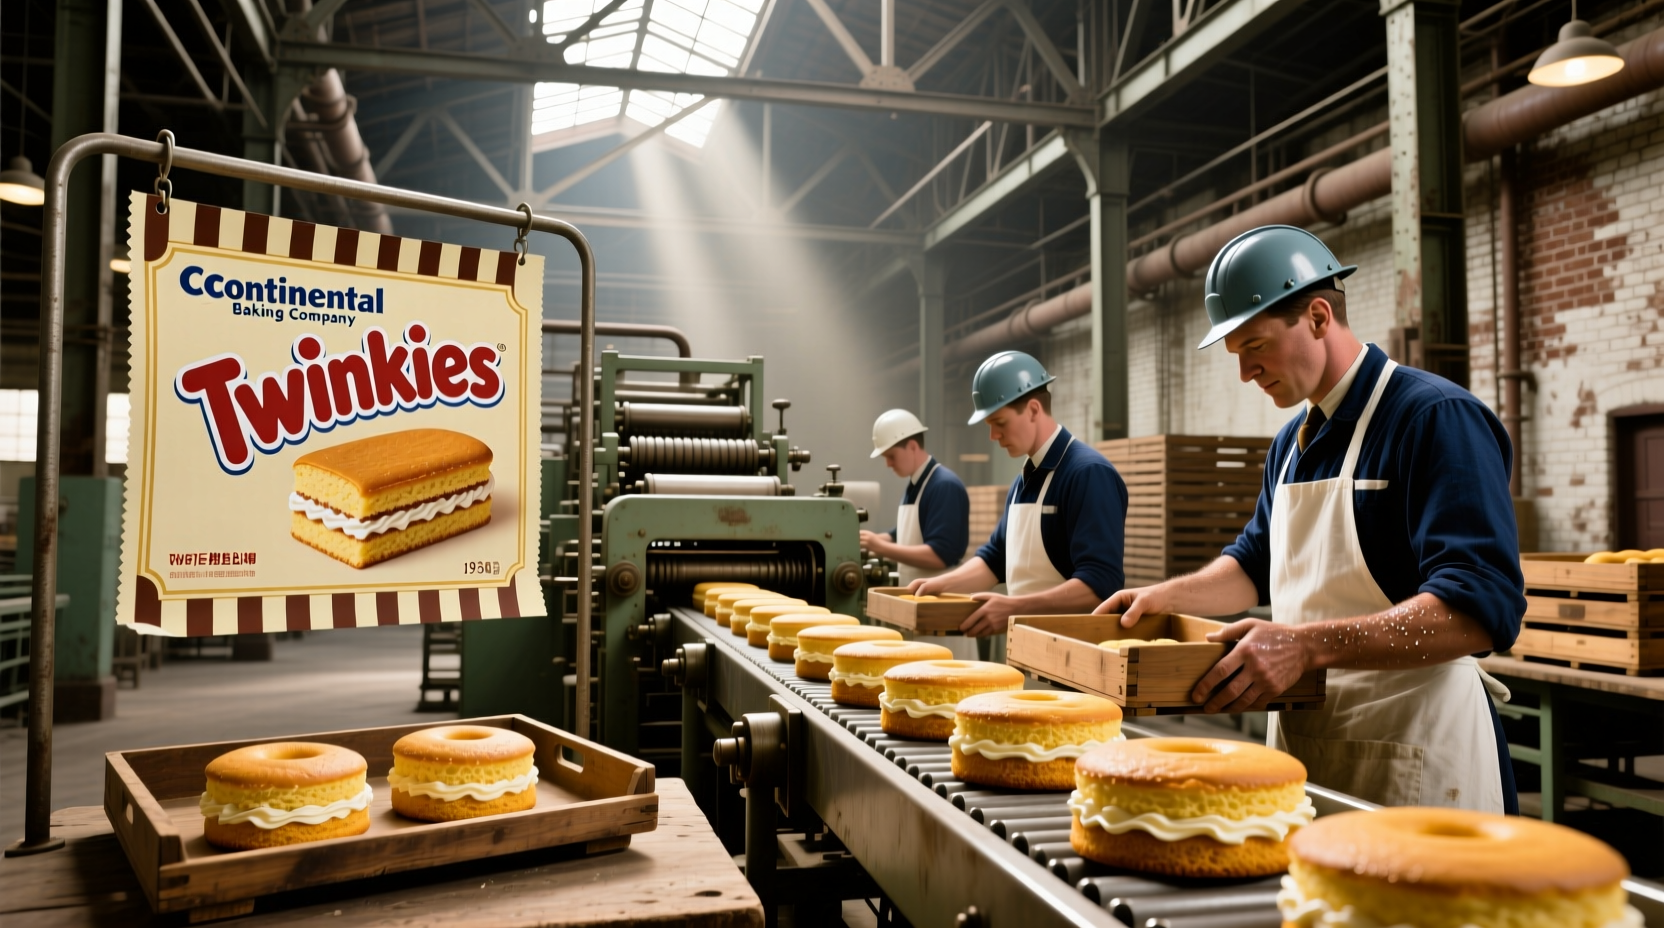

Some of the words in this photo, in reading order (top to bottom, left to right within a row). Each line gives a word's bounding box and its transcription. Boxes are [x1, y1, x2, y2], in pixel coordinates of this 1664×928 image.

[232, 302, 284, 322] Baking
[289, 307, 356, 328] Company
[175, 320, 504, 476] Twinkies
